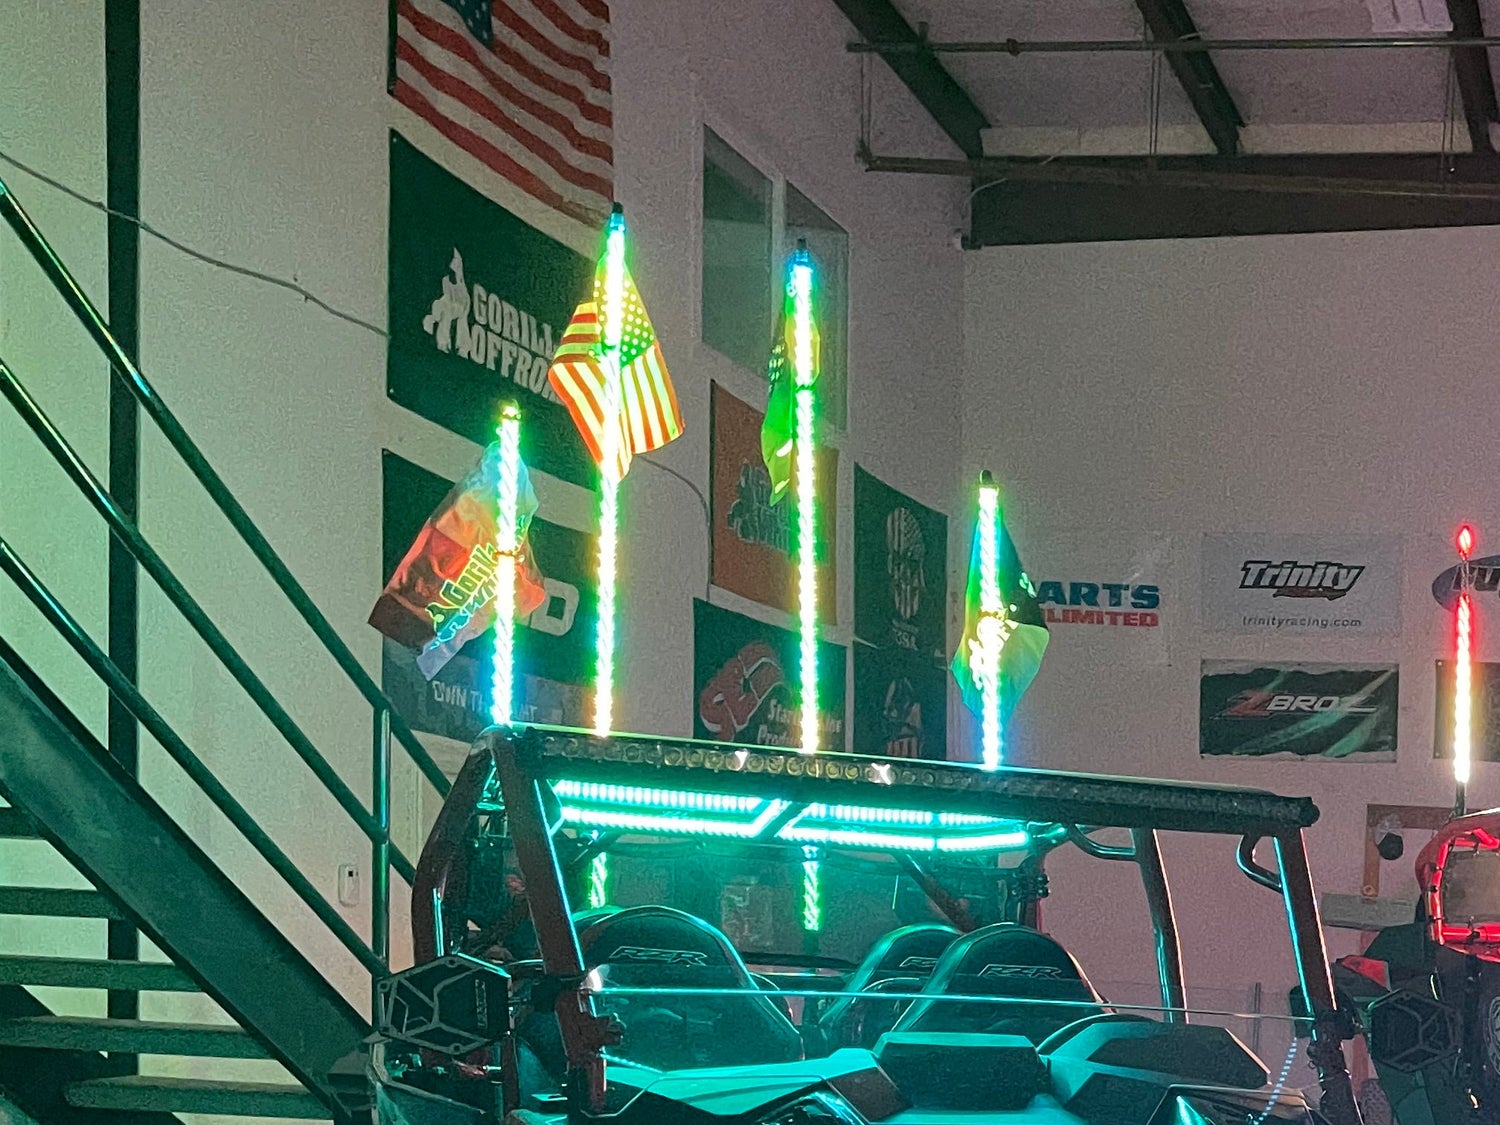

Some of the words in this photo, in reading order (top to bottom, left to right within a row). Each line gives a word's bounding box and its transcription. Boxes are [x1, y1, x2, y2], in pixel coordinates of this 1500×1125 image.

[473, 283, 557, 361] GORILL
[470, 324, 563, 405] OFFRO
[1240, 561, 1365, 592] Trinity
[1037, 581, 1160, 609] ARTS
[1042, 608, 1159, 627] LIMITED
[1243, 616, 1362, 628] trinityracing.com
